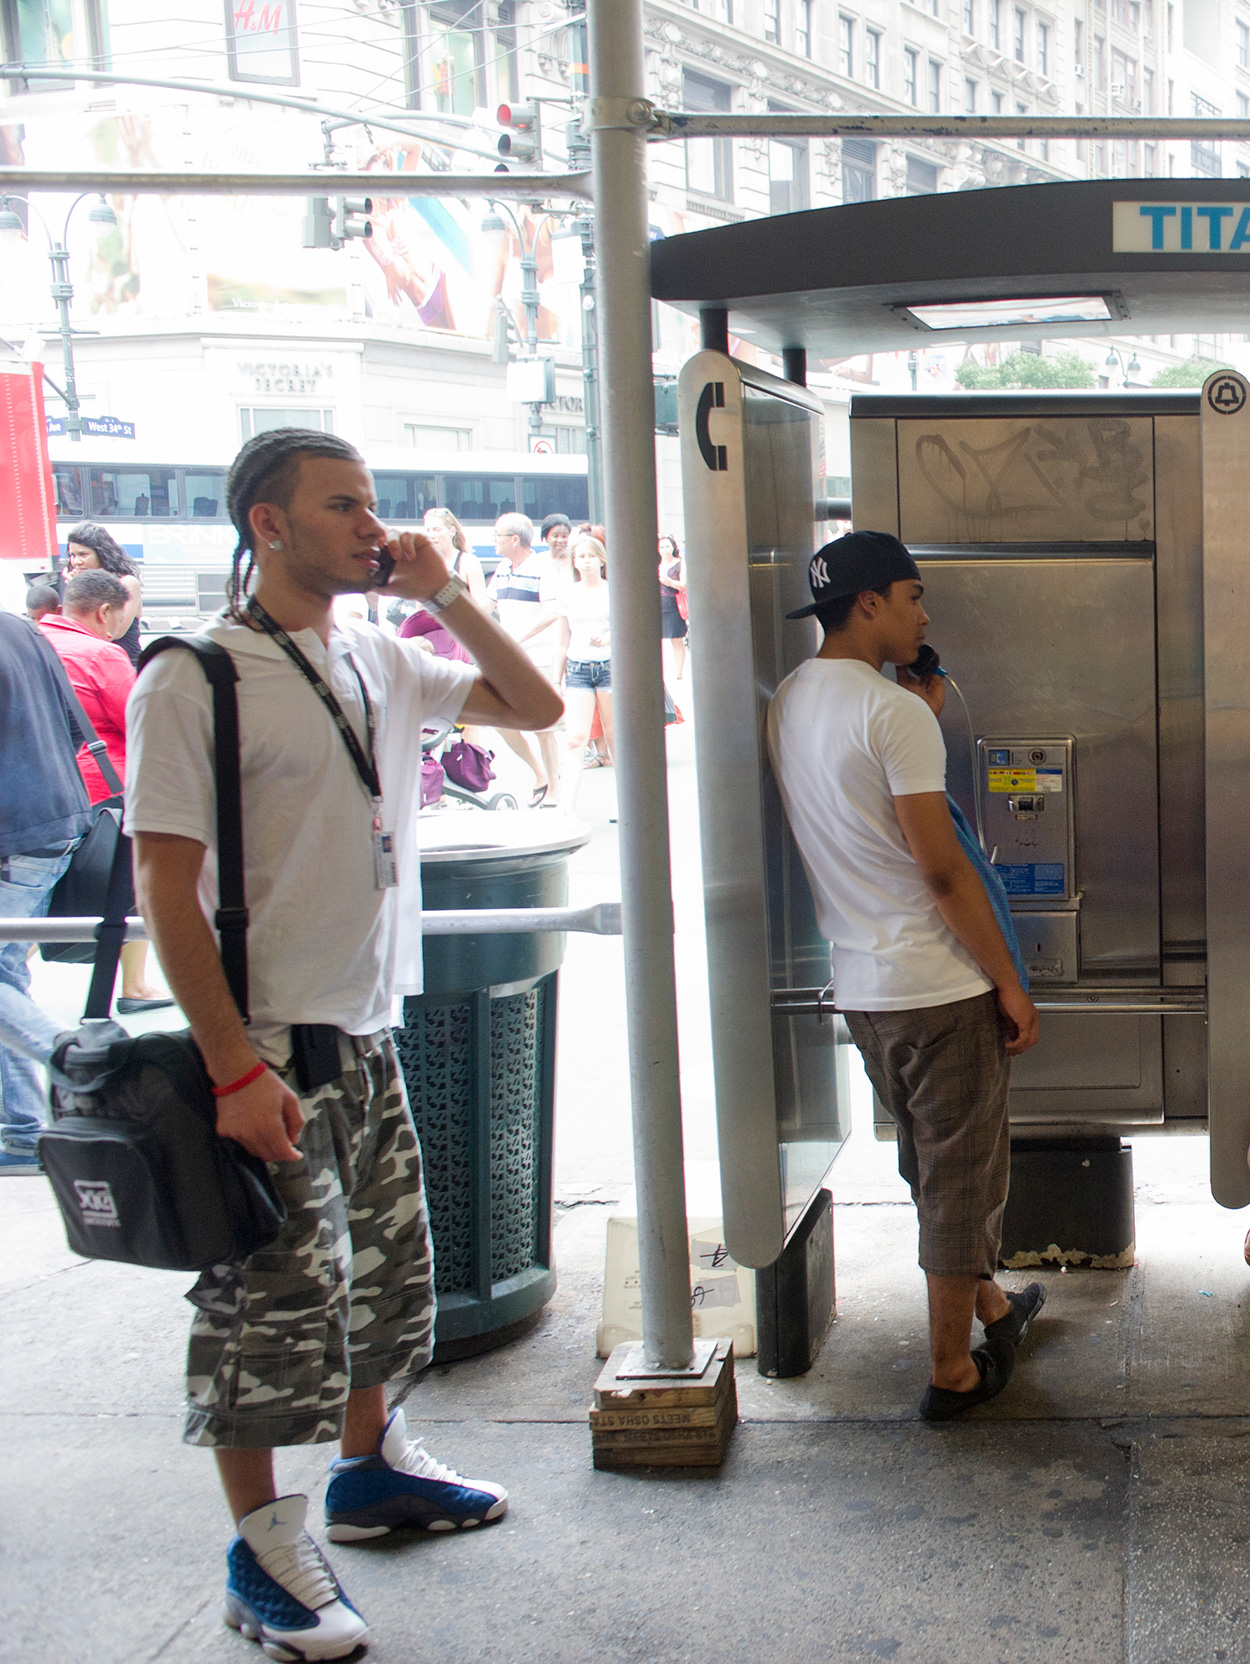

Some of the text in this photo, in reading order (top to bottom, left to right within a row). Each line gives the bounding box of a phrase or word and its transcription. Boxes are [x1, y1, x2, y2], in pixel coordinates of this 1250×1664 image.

[233, 0, 282, 35] H&M
[236, 360, 333, 378] VICTORIA'S
[255, 378, 316, 393] SECRET
[88, 421, 108, 433] West
[123, 425, 132, 436] St
[810, 557, 831, 588] NY
[618, 1416, 649, 1427] OSHA
[653, 1413, 691, 1425] MEETS
